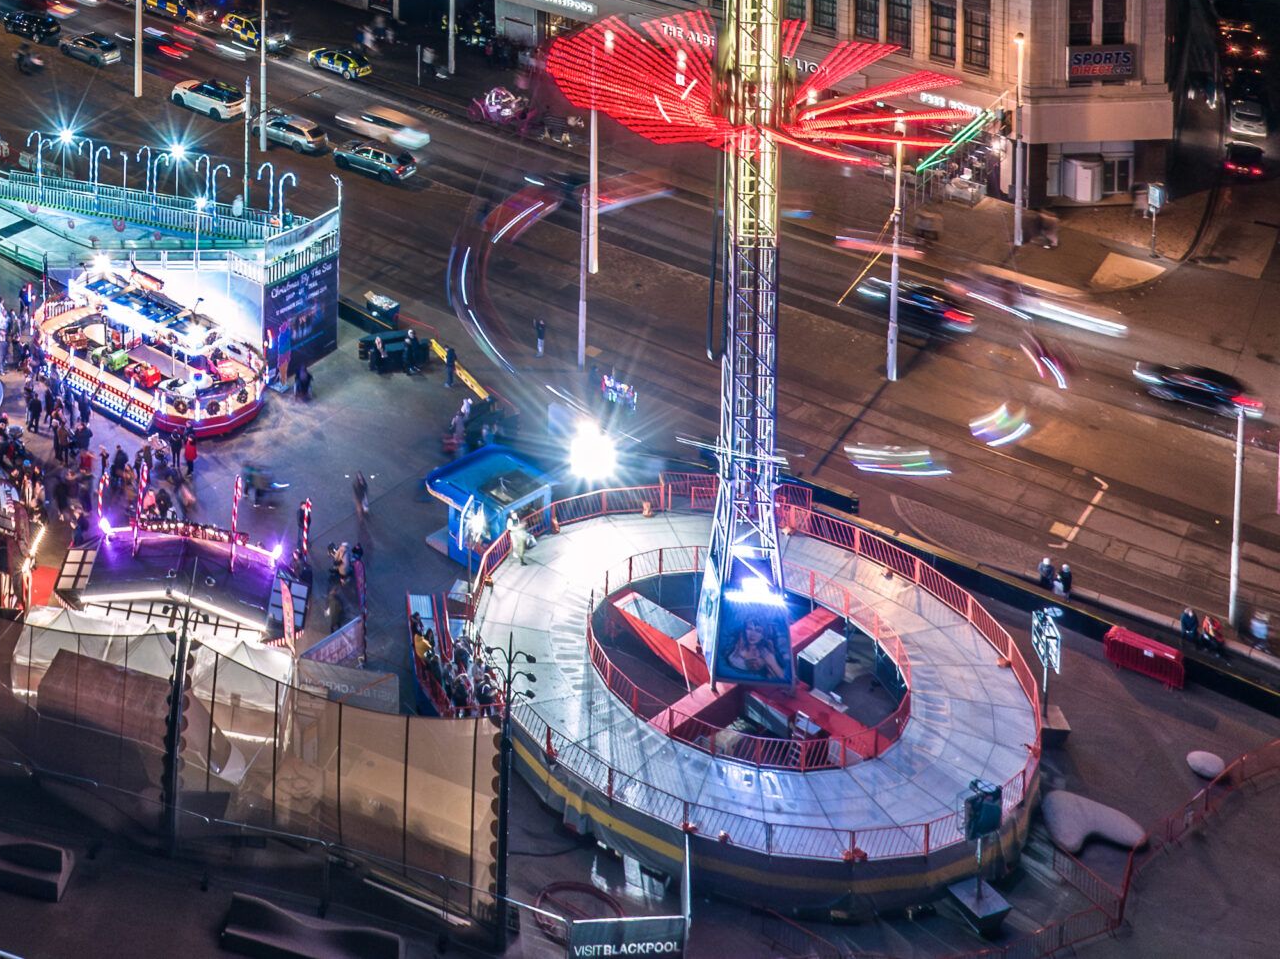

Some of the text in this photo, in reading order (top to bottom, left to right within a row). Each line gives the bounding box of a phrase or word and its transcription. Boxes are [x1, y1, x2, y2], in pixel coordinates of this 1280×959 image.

[661, 22, 684, 40] THE
[795, 58, 829, 77] LION
[1072, 51, 1131, 65] SPORTS
[271, 279, 300, 299] Christmas
[301, 273, 310, 287] By
[310, 267, 321, 279] The
[322, 262, 332, 273] Sea
[573, 942, 682, 957] VISITBLACKPOOL
